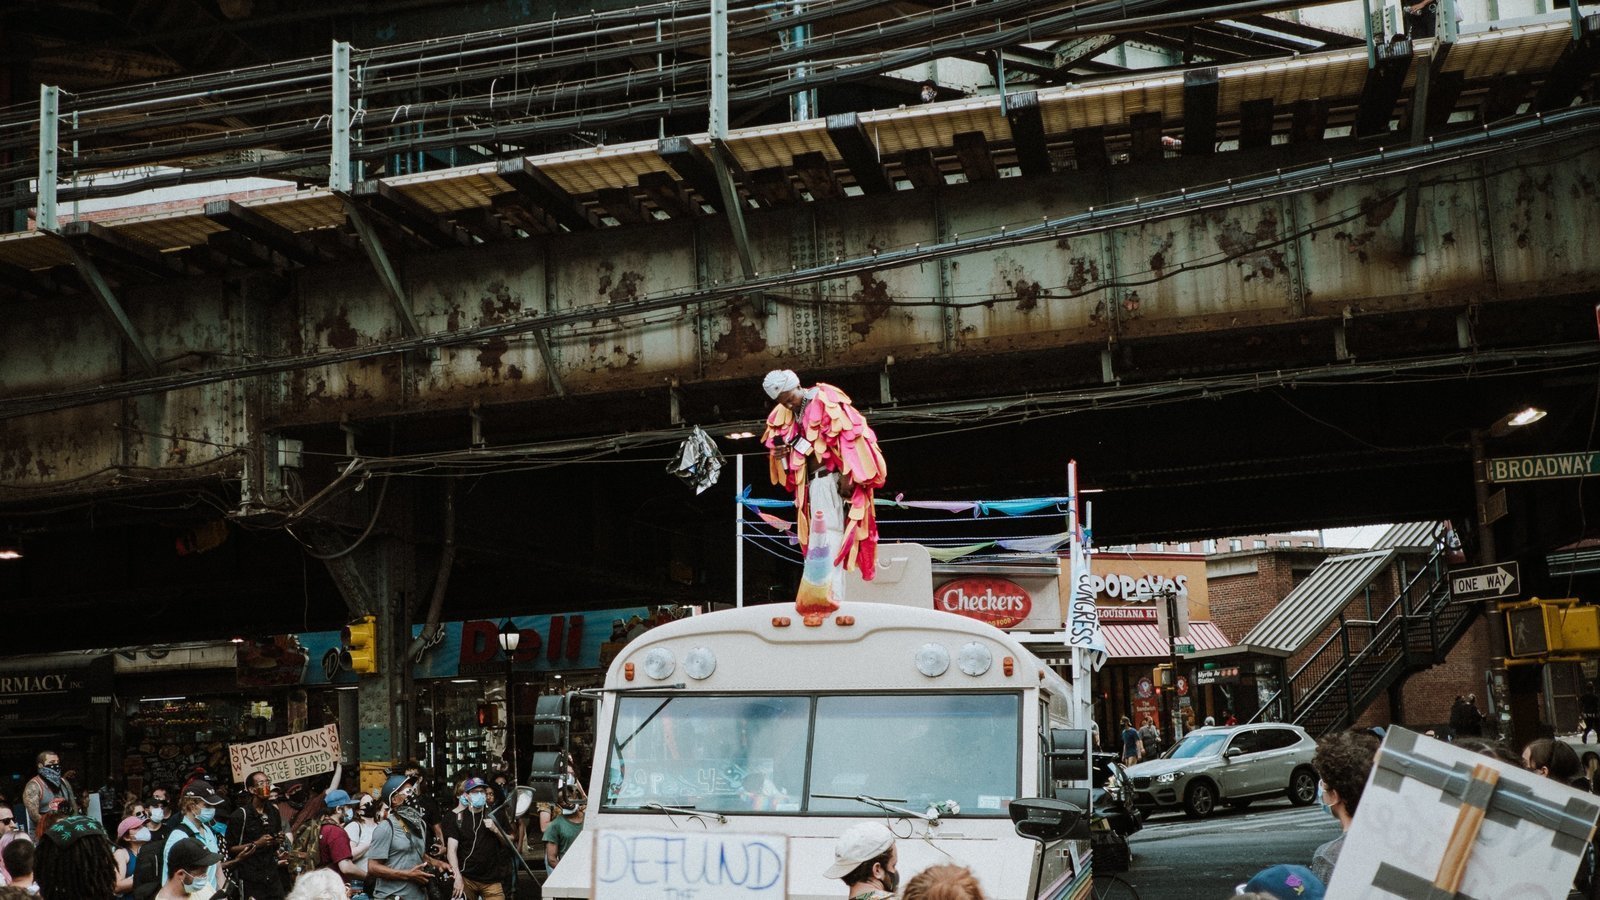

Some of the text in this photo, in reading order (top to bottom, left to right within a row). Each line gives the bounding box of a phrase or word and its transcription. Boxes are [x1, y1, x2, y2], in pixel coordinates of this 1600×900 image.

[1495, 454, 1594, 479] BROADWAY
[1459, 573, 1507, 592] ONE WAY
[943, 588, 1025, 611] Checkers
[1070, 574, 1097, 644] CONGRESS
[1098, 609, 1144, 618] LOUISIANA
[460, 616, 584, 663] Deli
[240, 731, 327, 764] REPARATIONS
[294, 751, 331, 767] DELAYED
[268, 770, 290, 782] STICE
[599, 834, 782, 890] DEFUND
